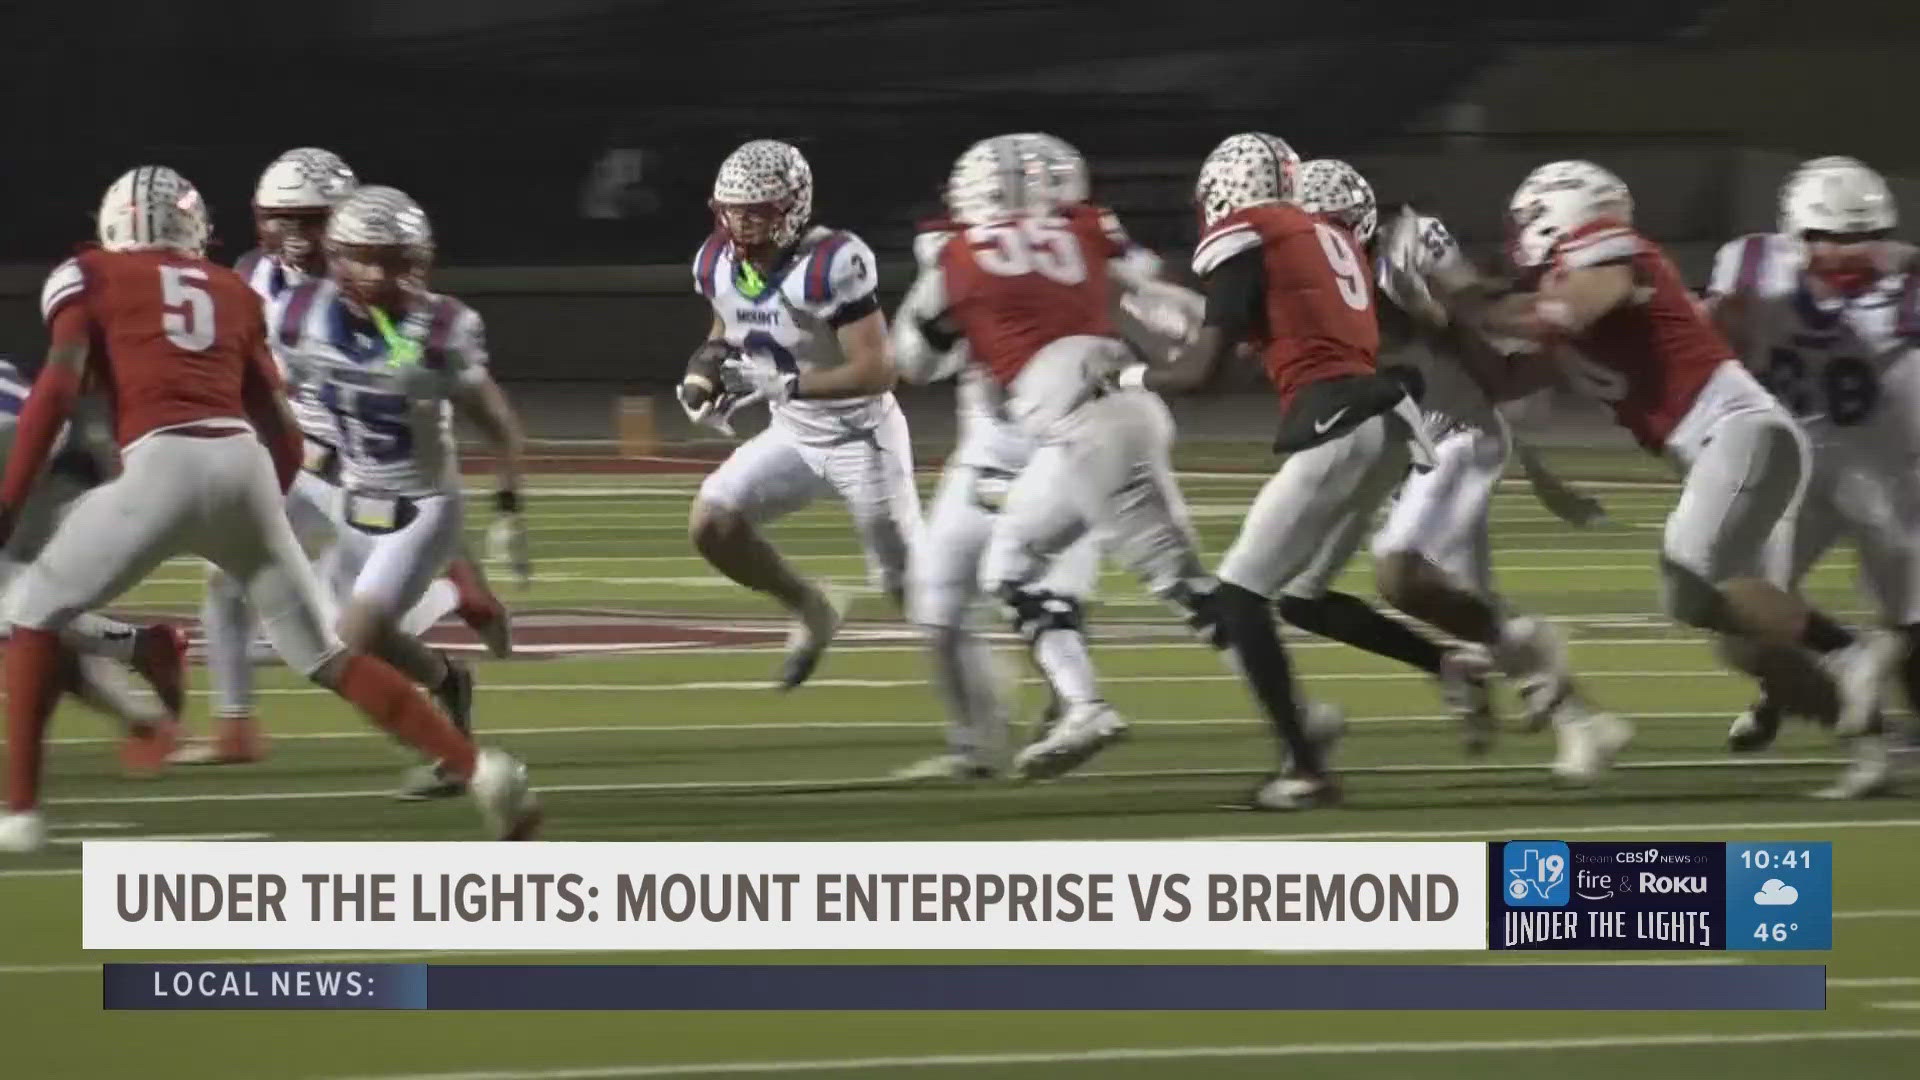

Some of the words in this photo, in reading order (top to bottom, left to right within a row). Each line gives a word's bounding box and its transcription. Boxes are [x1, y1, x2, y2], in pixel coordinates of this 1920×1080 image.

[850, 253, 868, 281] 3
[965, 216, 1088, 286] 55
[1313, 223, 1369, 311] 9
[159, 265, 215, 351] 5
[735, 307, 781, 326] MOUNT
